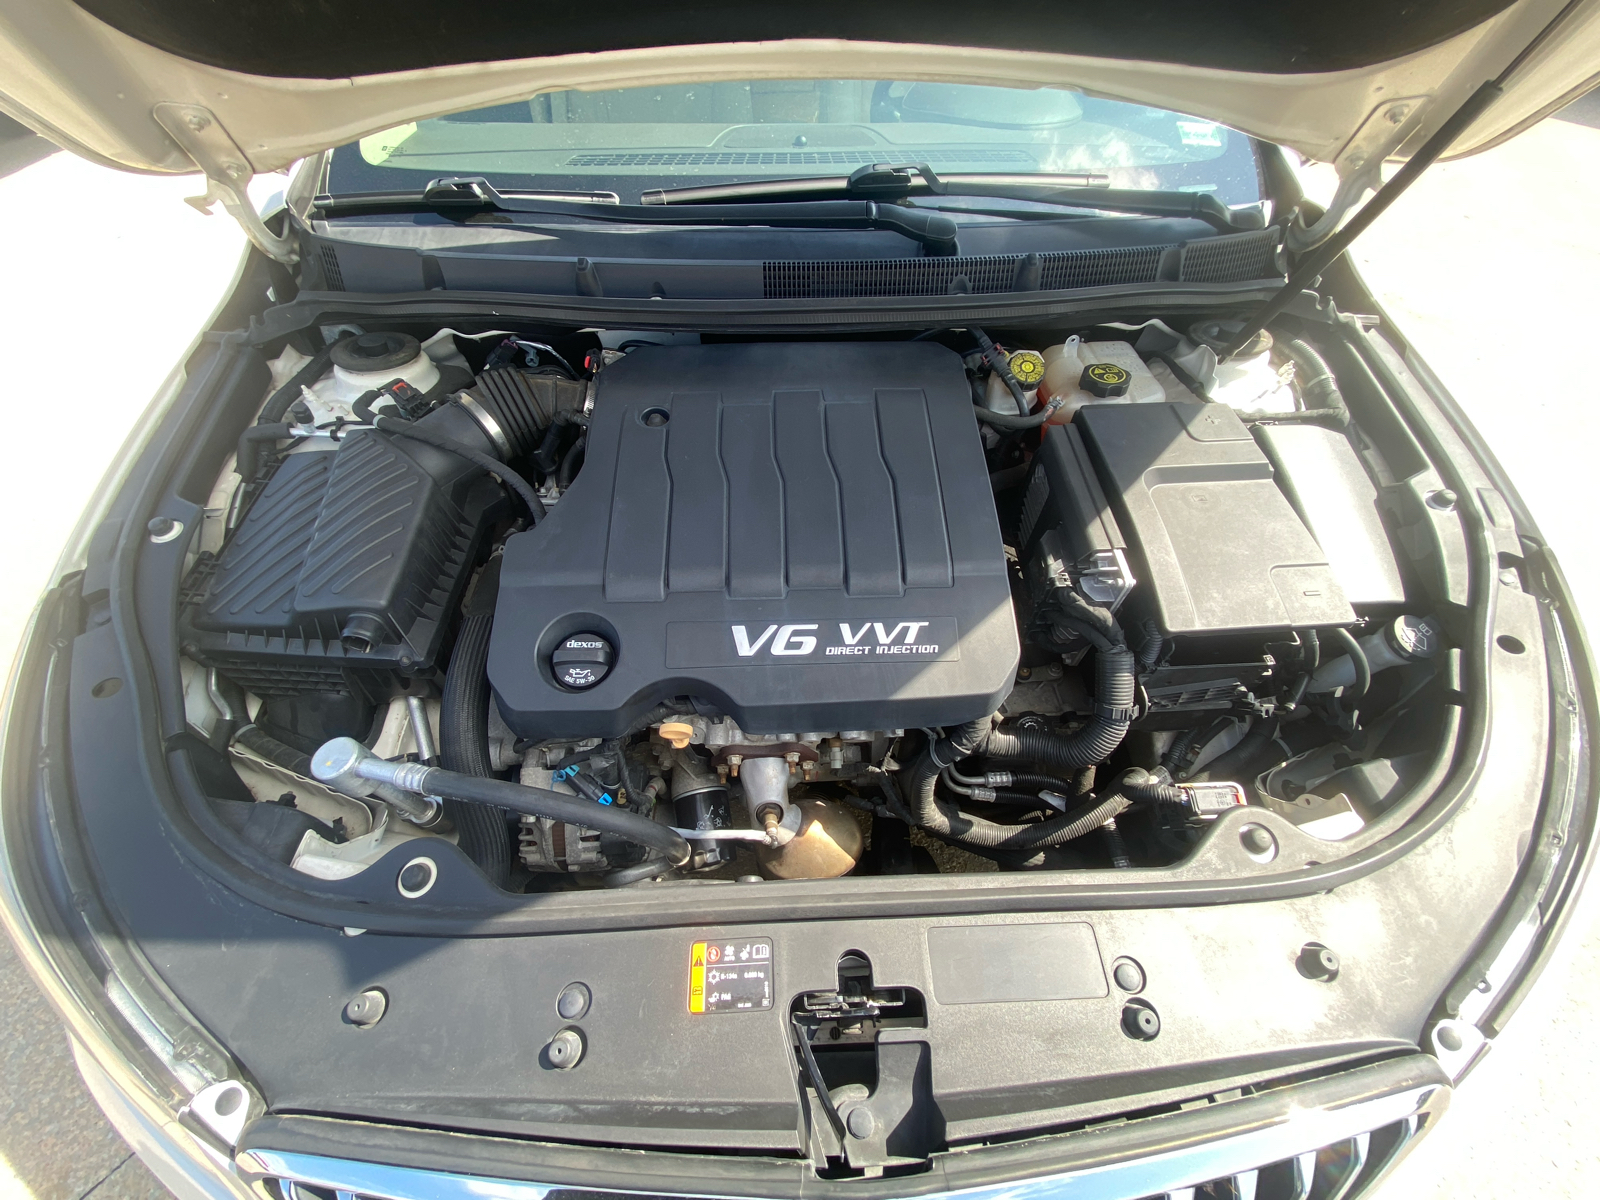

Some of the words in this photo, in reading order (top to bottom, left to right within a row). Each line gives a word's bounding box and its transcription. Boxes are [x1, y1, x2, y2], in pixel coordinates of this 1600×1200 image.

[731, 624, 819, 657] V6
[839, 621, 930, 645] VVT
[566, 640, 604, 649] dexos
[825, 646, 872, 656] DIRECT
[875, 644, 939, 654] INJECTION
[564, 675, 576, 684] SAE
[575, 675, 596, 684] 5W-30
